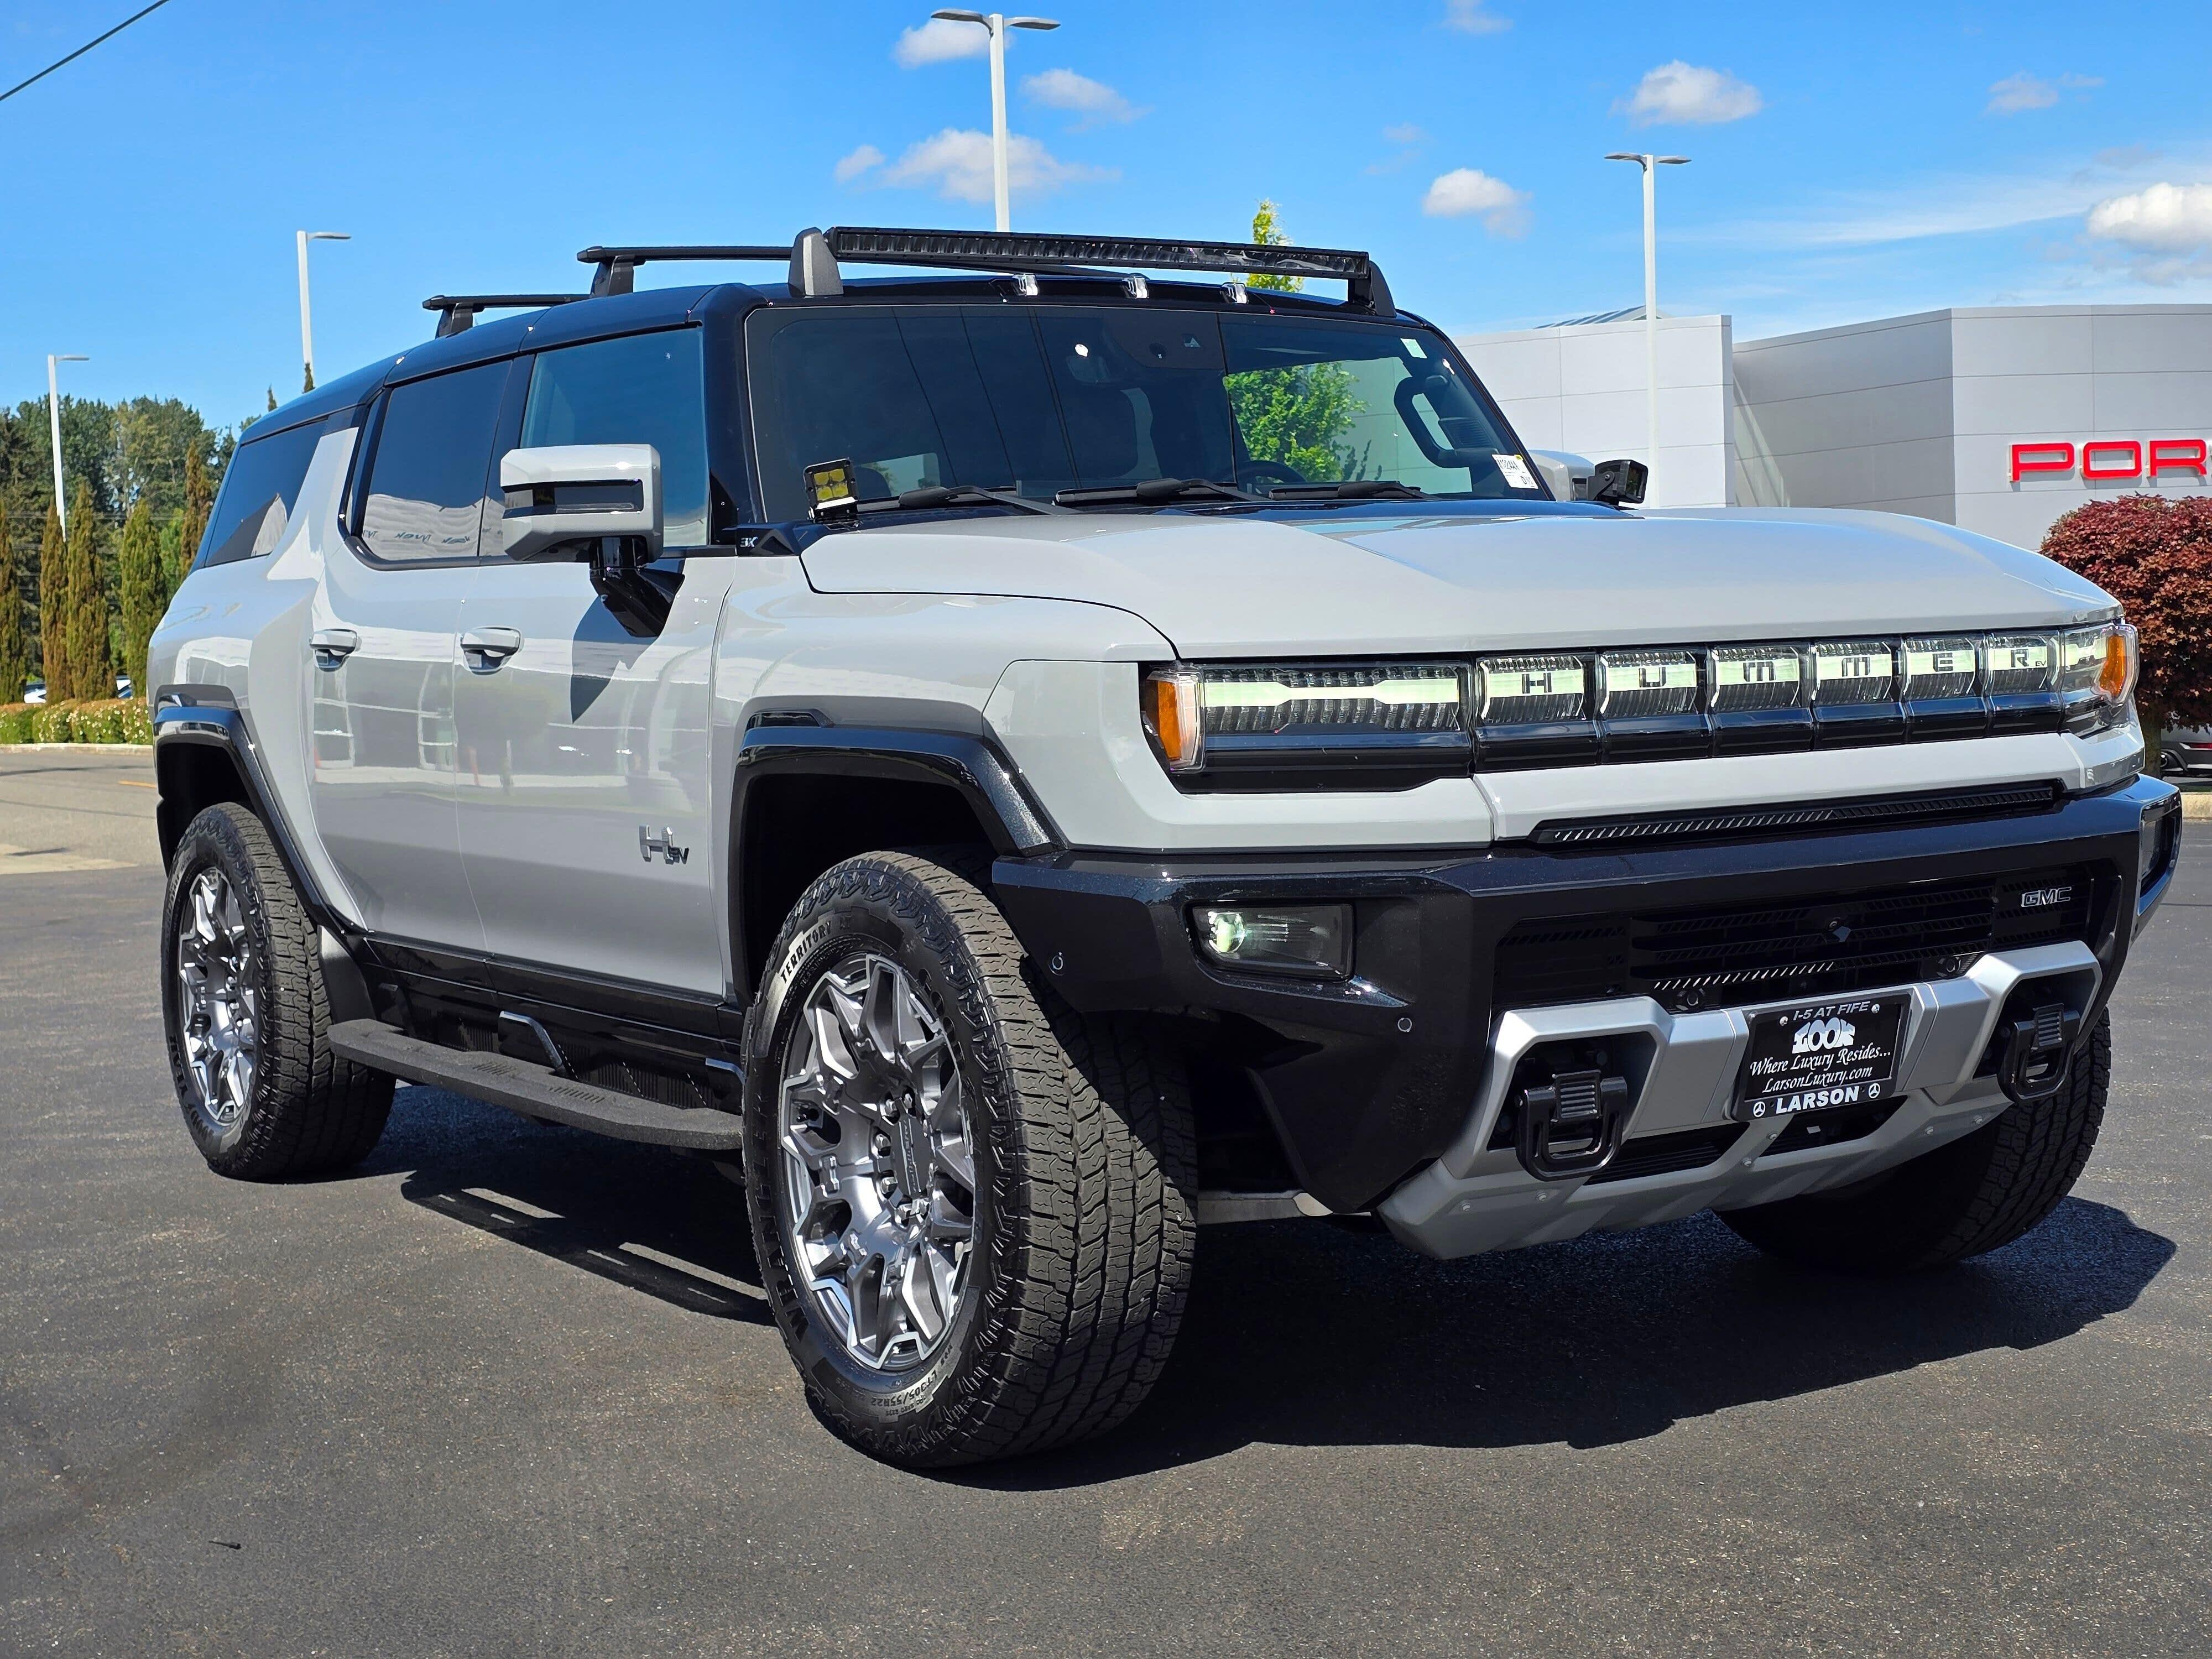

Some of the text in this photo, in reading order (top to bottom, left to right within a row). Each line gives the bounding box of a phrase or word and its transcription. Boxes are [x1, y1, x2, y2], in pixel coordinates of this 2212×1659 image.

[2021, 886, 2072, 907] GMC
[780, 920, 832, 984] TERRITORY
[1793, 1000, 1871, 1021] I-5 AT FIFE
[1750, 1057, 1788, 1076] Where
[1790, 1053, 1834, 1071] Luxury
[1762, 1066, 1873, 1093] LarsonLuxury.com
[1776, 1086, 1860, 1114] LARSON
